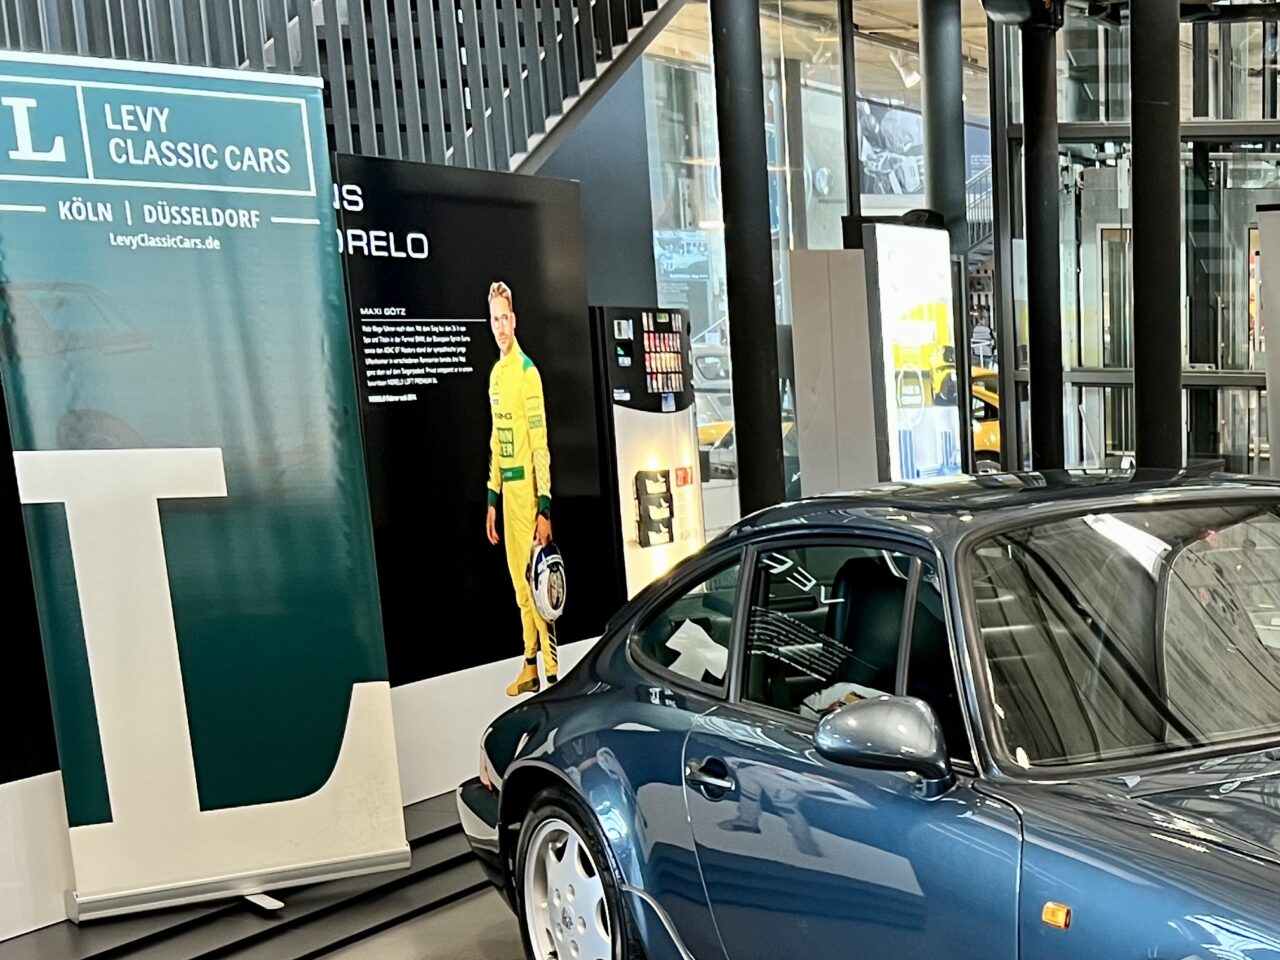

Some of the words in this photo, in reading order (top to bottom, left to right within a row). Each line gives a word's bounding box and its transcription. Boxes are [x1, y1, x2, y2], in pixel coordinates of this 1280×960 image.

[0, 97, 66, 162] L
[104, 103, 170, 133] LEVY
[109, 138, 219, 170] CLASSIC
[224, 145, 291, 175] CARS
[58, 196, 113, 222] KÖLN
[143, 201, 260, 228] DÜSSELDORF
[109, 232, 221, 250] LevyClassicCars.de
[360, 307, 382, 315] MAXI
[384, 307, 406, 316] GÖTZ
[13, 447, 405, 894] L
